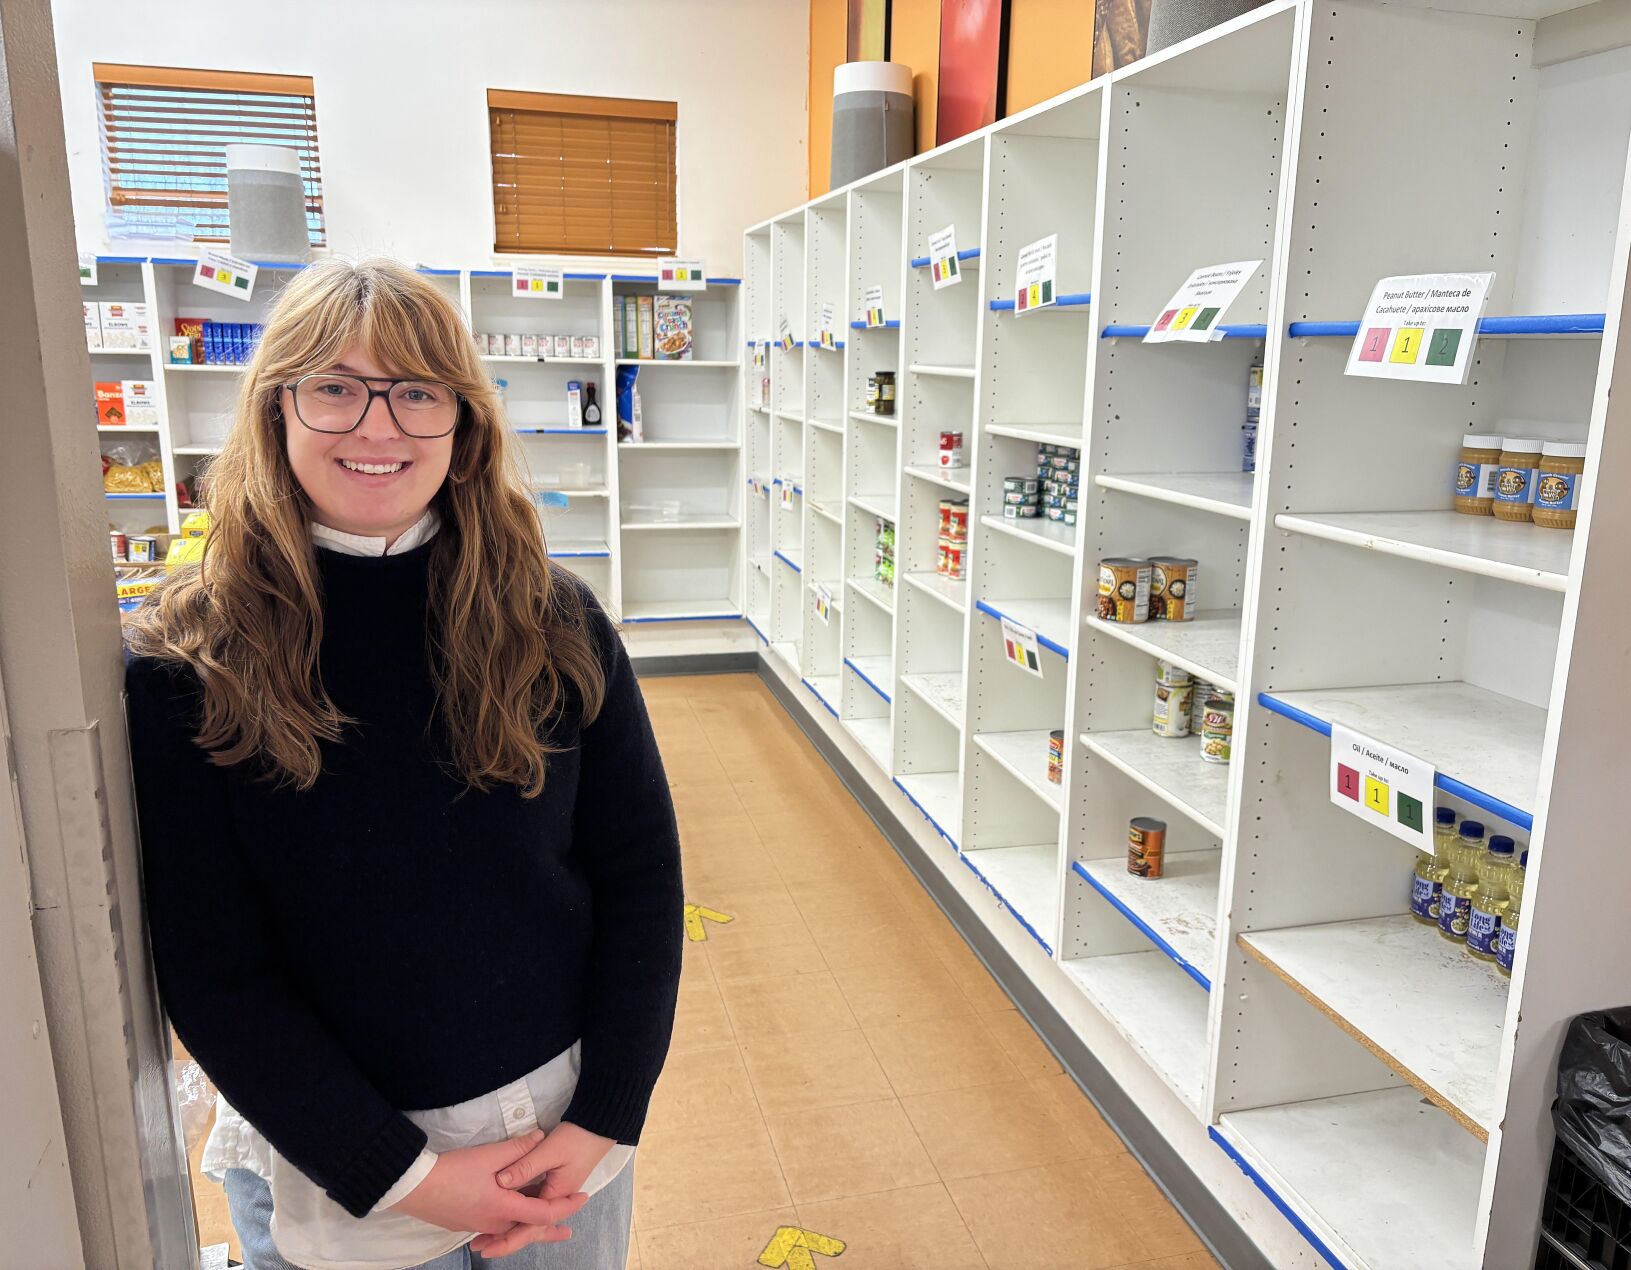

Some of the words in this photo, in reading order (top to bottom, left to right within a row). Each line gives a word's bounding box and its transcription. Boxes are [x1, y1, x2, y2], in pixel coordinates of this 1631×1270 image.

[1383, 291, 1404, 300] Peanut
[1405, 290, 1425, 298] Butter
[1431, 289, 1461, 298] Manteca
[1462, 288, 1472, 297] de
[1376, 305, 1406, 313] Cacahuete
[1446, 305, 1469, 313] масло
[1370, 336, 1378, 352] 1
[1401, 336, 1411, 353] 1
[1438, 337, 1449, 355] 2
[117, 586, 151, 597] ARGE
[1352, 743, 1361, 753] Oil
[1365, 750, 1384, 763] Aceite
[1389, 761, 1409, 775] масло
[1345, 774, 1352, 790] 1
[1373, 788, 1380, 804] 1
[1407, 804, 1413, 821] 1
